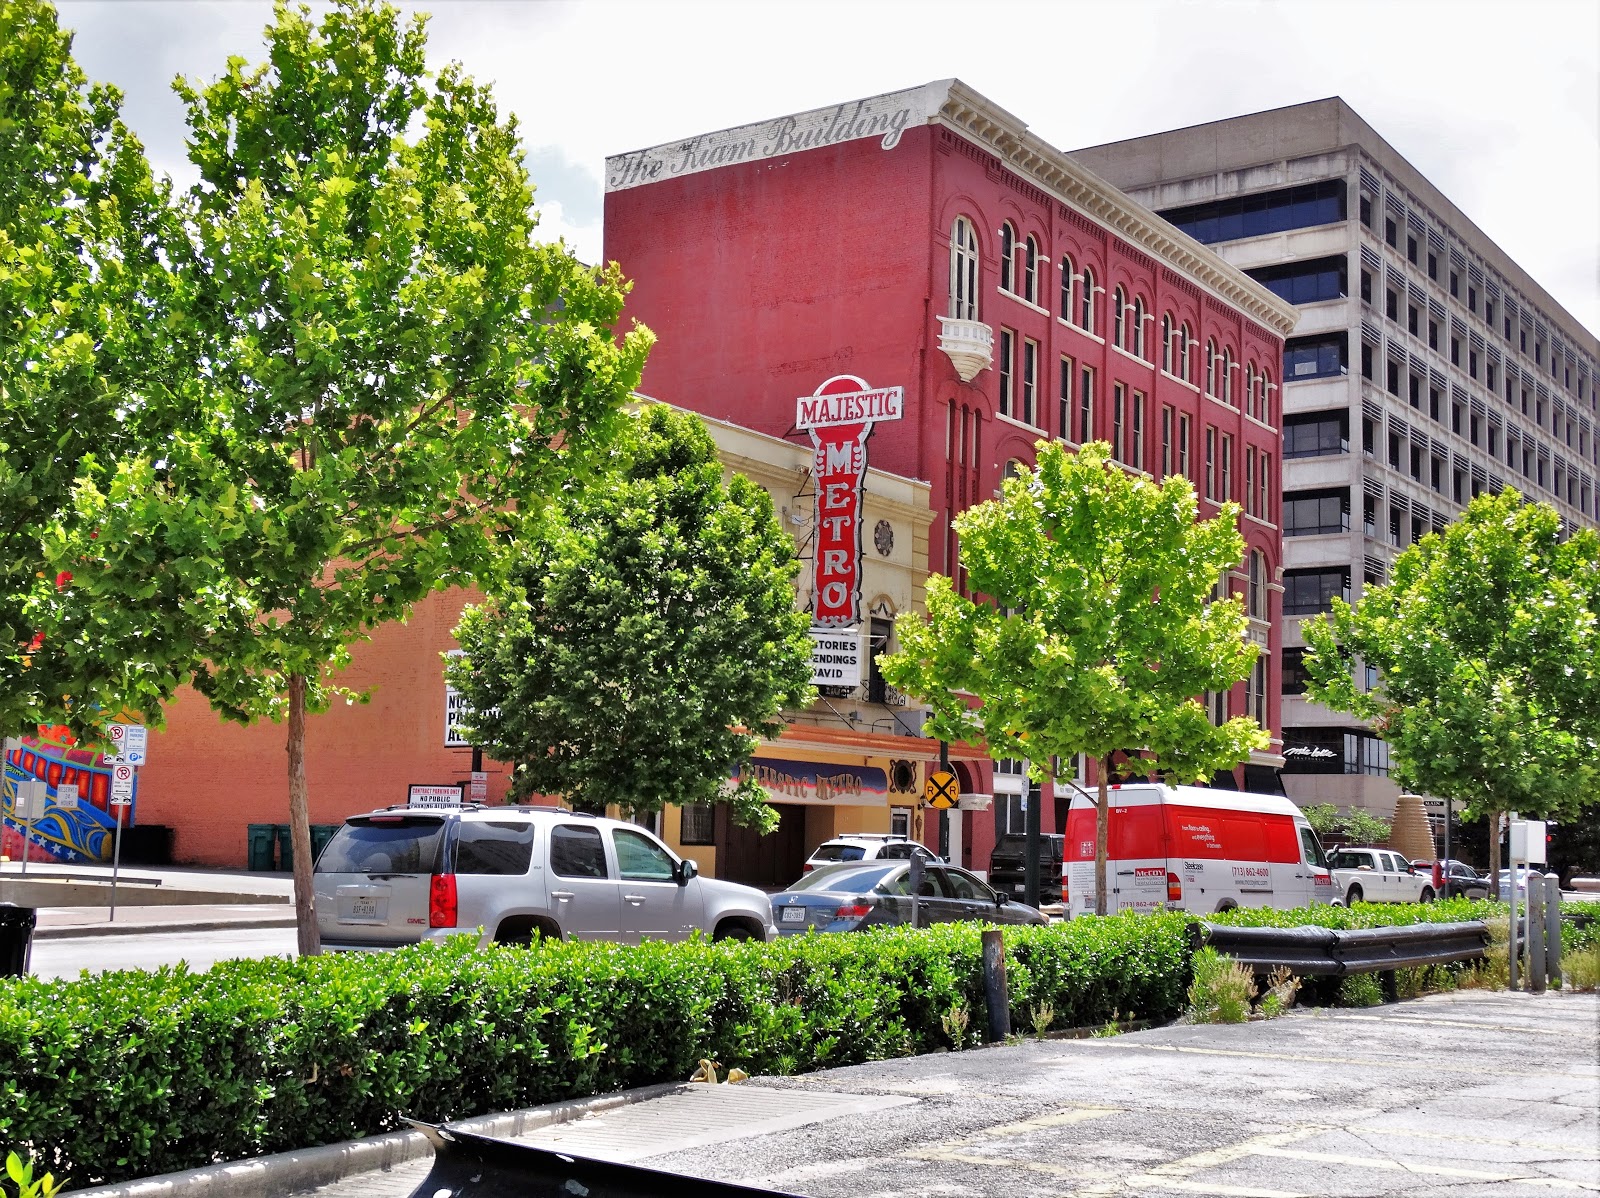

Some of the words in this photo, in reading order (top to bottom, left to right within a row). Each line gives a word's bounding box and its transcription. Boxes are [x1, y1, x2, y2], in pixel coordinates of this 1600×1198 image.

[610, 152, 663, 187] The
[670, 134, 755, 174] Kiam
[762, 101, 910, 155] Building
[801, 391, 898, 425] MAJESTIC
[822, 441, 852, 609] METRO
[815, 774, 864, 800] METRO
[927, 786, 934, 795] R
[950, 786, 957, 795] R
[1231, 866, 1245, 877] (713)
[1246, 867, 1269, 877] 862-4600
